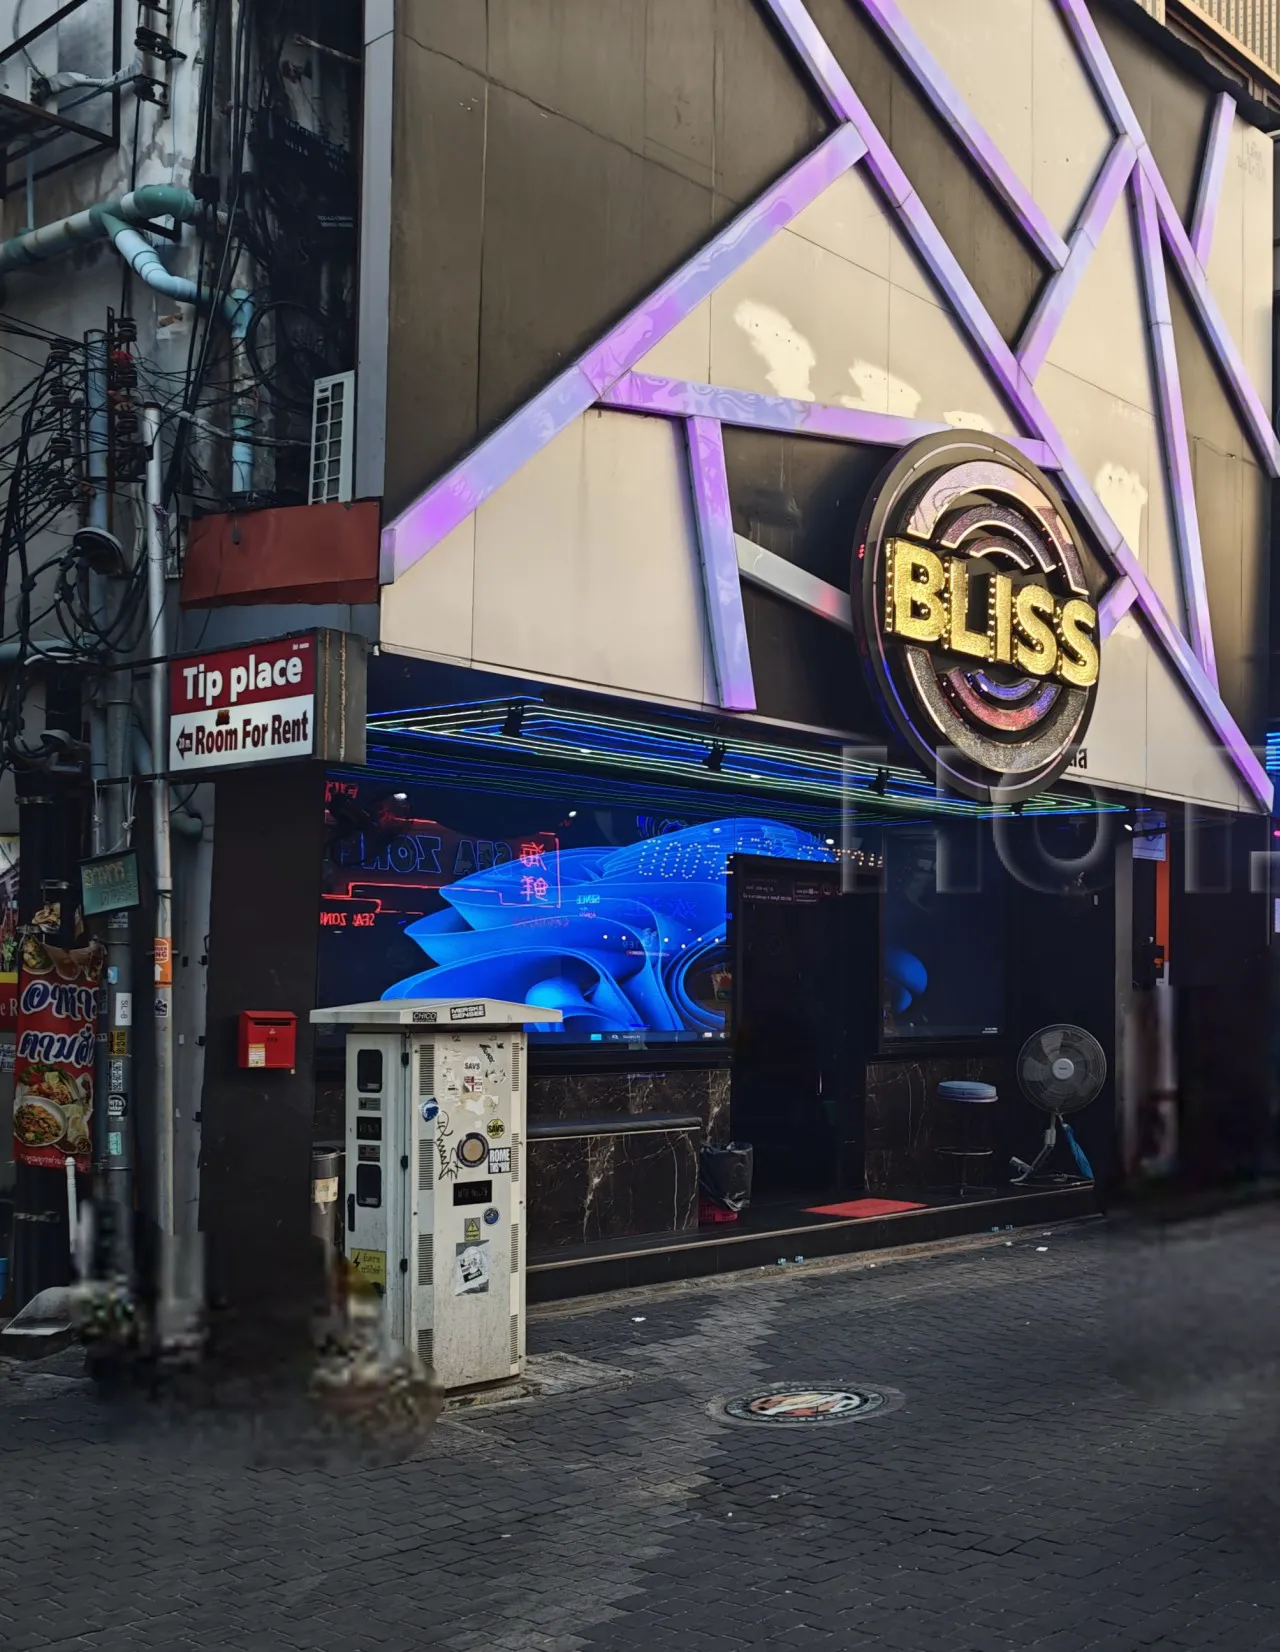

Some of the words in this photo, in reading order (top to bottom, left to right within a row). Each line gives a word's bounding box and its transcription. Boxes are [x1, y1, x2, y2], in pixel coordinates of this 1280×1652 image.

[885, 537, 1099, 687] BLISS
[183, 663, 223, 706] Tip
[230, 654, 303, 703] place
[195, 725, 238, 755] Room
[242, 718, 268, 749] For
[271, 709, 309, 745] Rent
[413, 1012, 436, 1020] CHICO
[17, 1023, 95, 1068] ตามสั่
[489, 1148, 511, 1162] ROME
